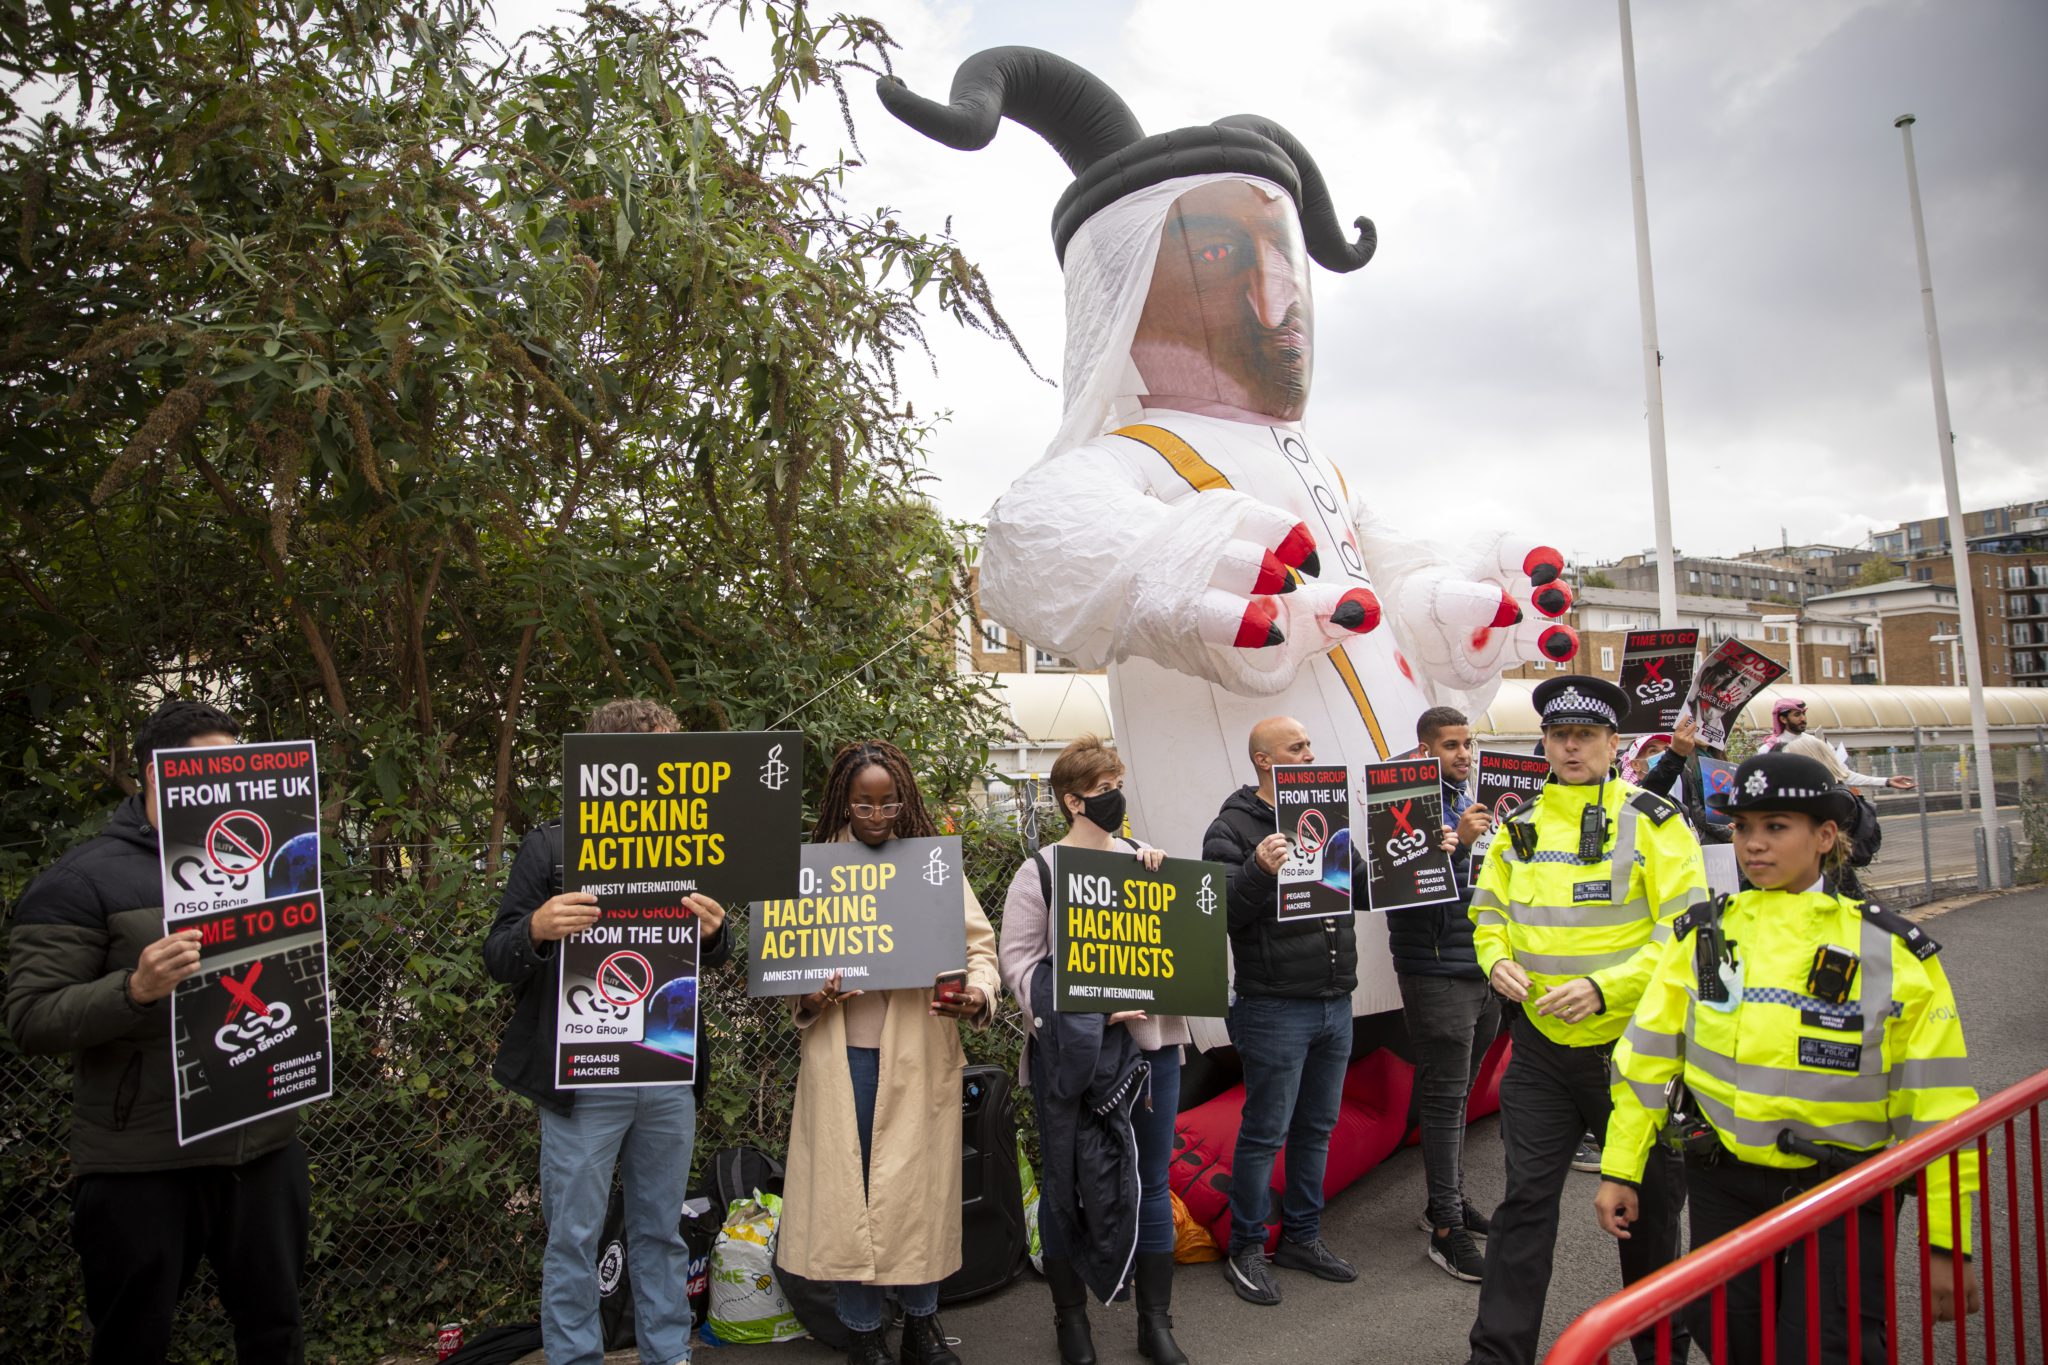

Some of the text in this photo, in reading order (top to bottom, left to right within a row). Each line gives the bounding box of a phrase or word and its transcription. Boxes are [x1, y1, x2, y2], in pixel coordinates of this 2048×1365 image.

[1631, 632, 1696, 647] TIME TO GO
[1721, 641, 1780, 678] BLOOD
[164, 751, 310, 778] BAN NSO GROUP
[1368, 764, 1437, 785] TIME TO GO
[1482, 756, 1549, 773] BAN NSO GROUP
[580, 761, 731, 797] NSO: STOP
[1277, 770, 1346, 784] BAN NSO GROUP
[1481, 772, 1510, 788] FROM
[1512, 776, 1531, 790] THE
[167, 776, 311, 808] FROM THE UK
[1279, 788, 1347, 804] FROM THE UK
[580, 798, 708, 834] HACKING
[578, 833, 725, 871] ACTIVISTS
[581, 880, 698, 896] AMNESTY INTERNATIONAL
[799, 863, 896, 894] O: STOP
[1068, 873, 1177, 912] NSO: STOP
[763, 894, 877, 928] HACKING
[176, 902, 317, 945] ME TO GO
[570, 926, 694, 944] FROM THE UK
[1068, 907, 1161, 944] HACKING
[761, 924, 894, 960] ACTIVISTS
[1067, 941, 1174, 979] ACTIVISTS
[762, 966, 869, 982] AMNESTY INTERNTIONAL
[1068, 985, 1155, 1000] AMNESTY INTERNATIONAL
[596, 1026, 628, 1034] GROUP
[1801, 1055, 1826, 1066] POLICE
[1824, 1048, 1849, 1057] POLICE
